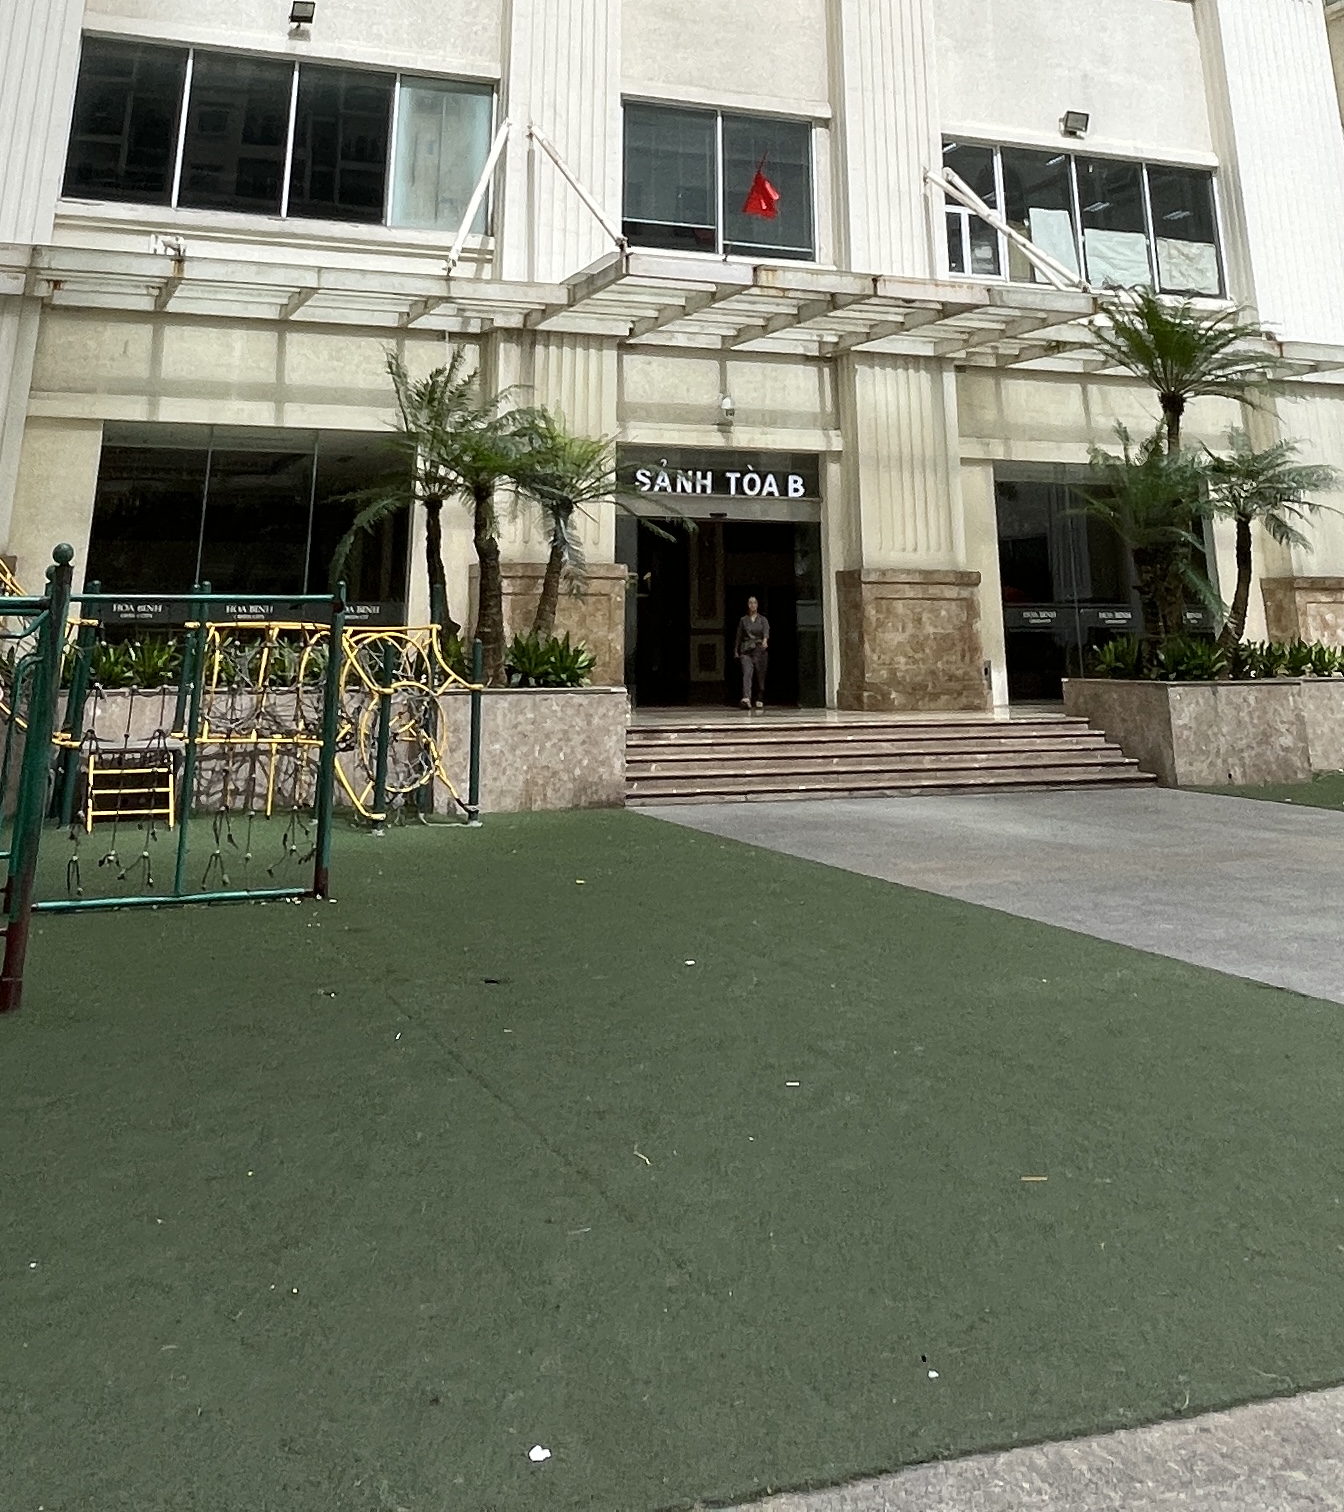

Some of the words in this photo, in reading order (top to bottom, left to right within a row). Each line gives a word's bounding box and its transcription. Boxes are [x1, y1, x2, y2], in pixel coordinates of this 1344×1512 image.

[635, 458, 713, 494] SẢNH
[725, 464, 781, 497] TÒA
[787, 474, 806, 498] B
